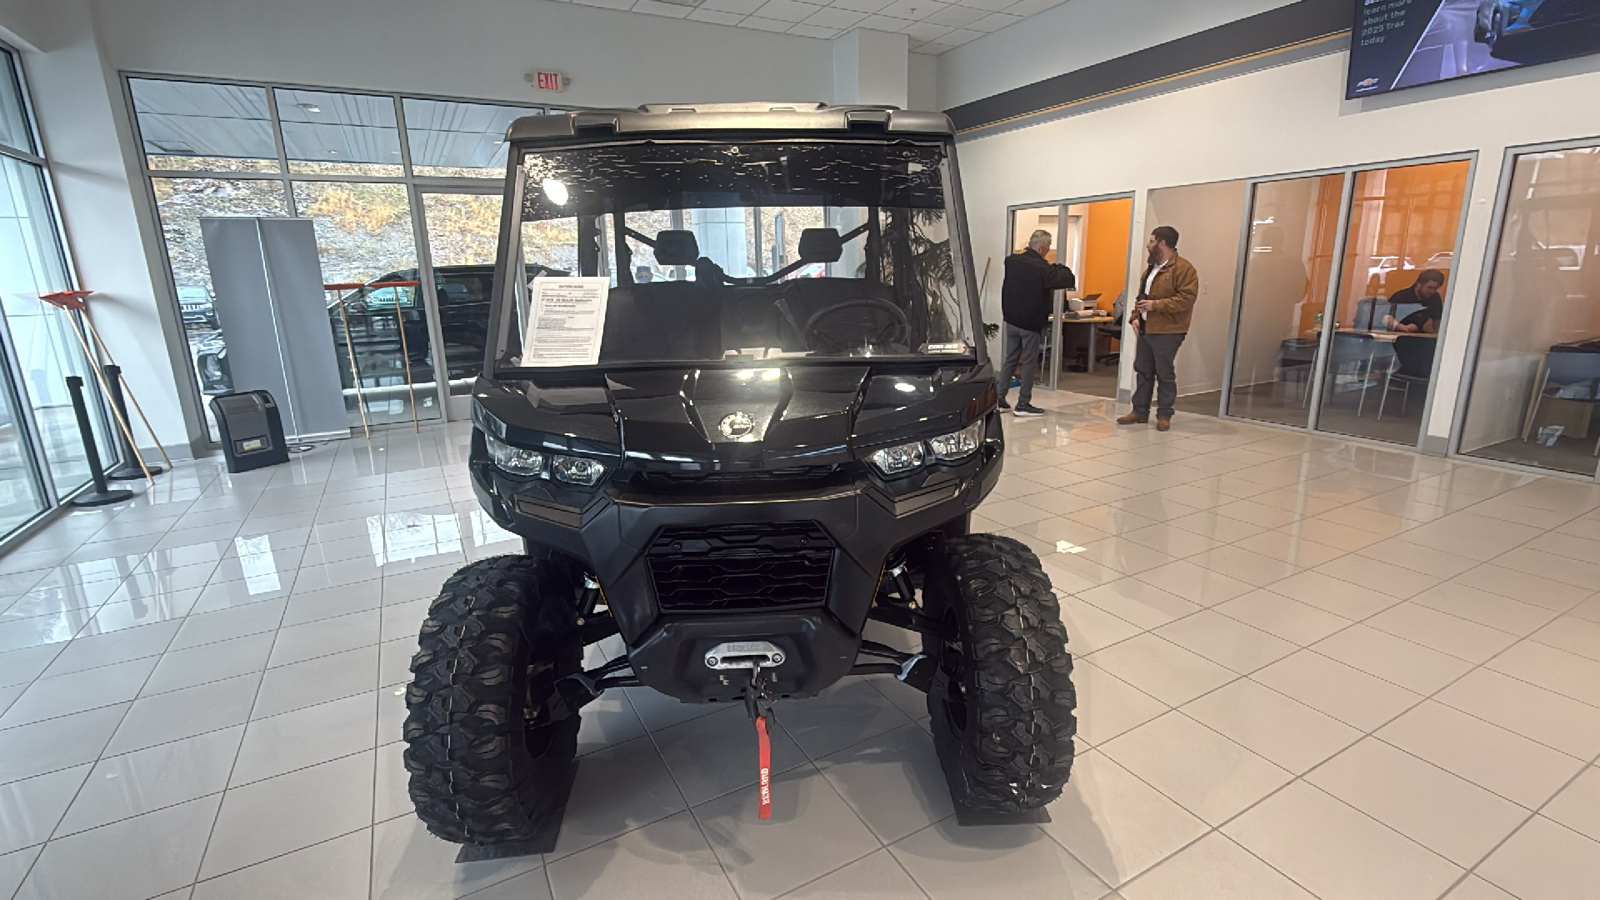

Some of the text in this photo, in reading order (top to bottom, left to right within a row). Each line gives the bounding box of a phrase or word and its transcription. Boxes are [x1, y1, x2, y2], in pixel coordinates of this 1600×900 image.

[1364, 4, 1386, 16] learn
[1363, 10, 1406, 26] about the
[1361, 35, 1385, 46] today
[537, 71, 559, 90] EXIT
